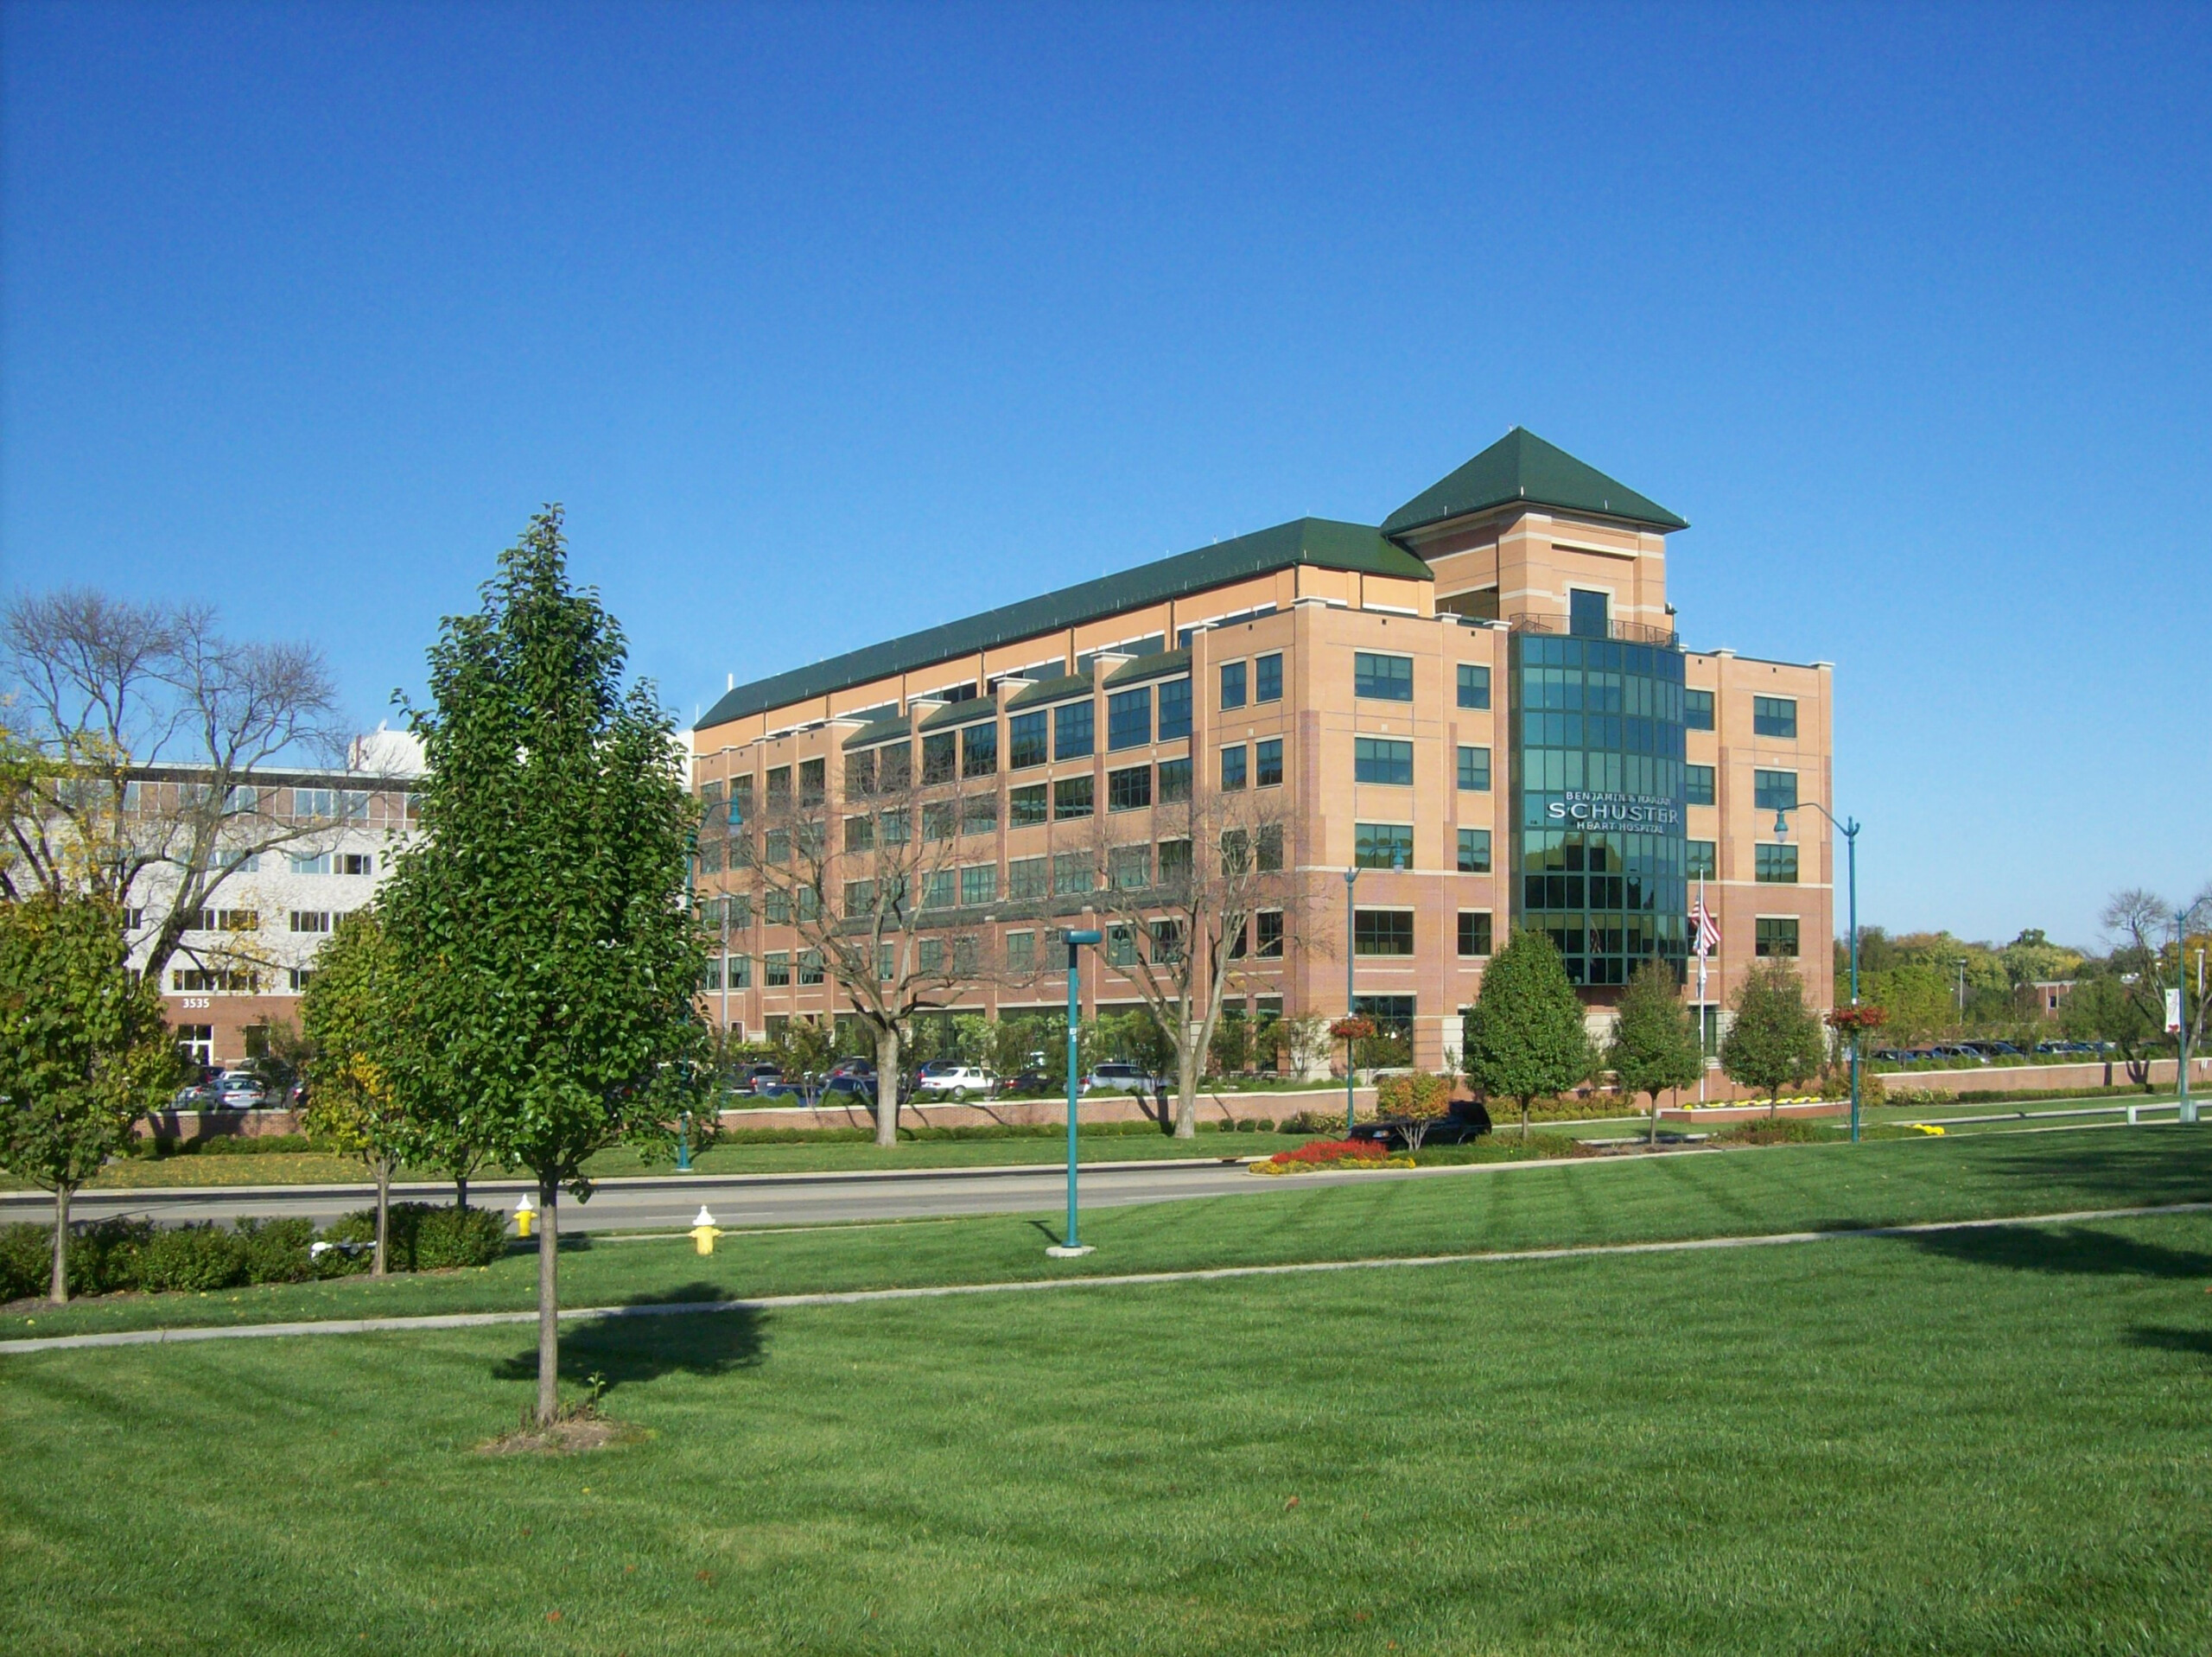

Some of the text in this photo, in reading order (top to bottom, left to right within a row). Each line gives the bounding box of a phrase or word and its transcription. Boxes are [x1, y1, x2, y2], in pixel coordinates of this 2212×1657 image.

[1566, 791, 1625, 803] BENJAMIN
[1628, 794, 1637, 803] &
[1548, 803, 1679, 824] SCHUSTER
[1577, 821, 1663, 835] HEART HOSPITAL
[182, 998, 210, 1008] 3535
